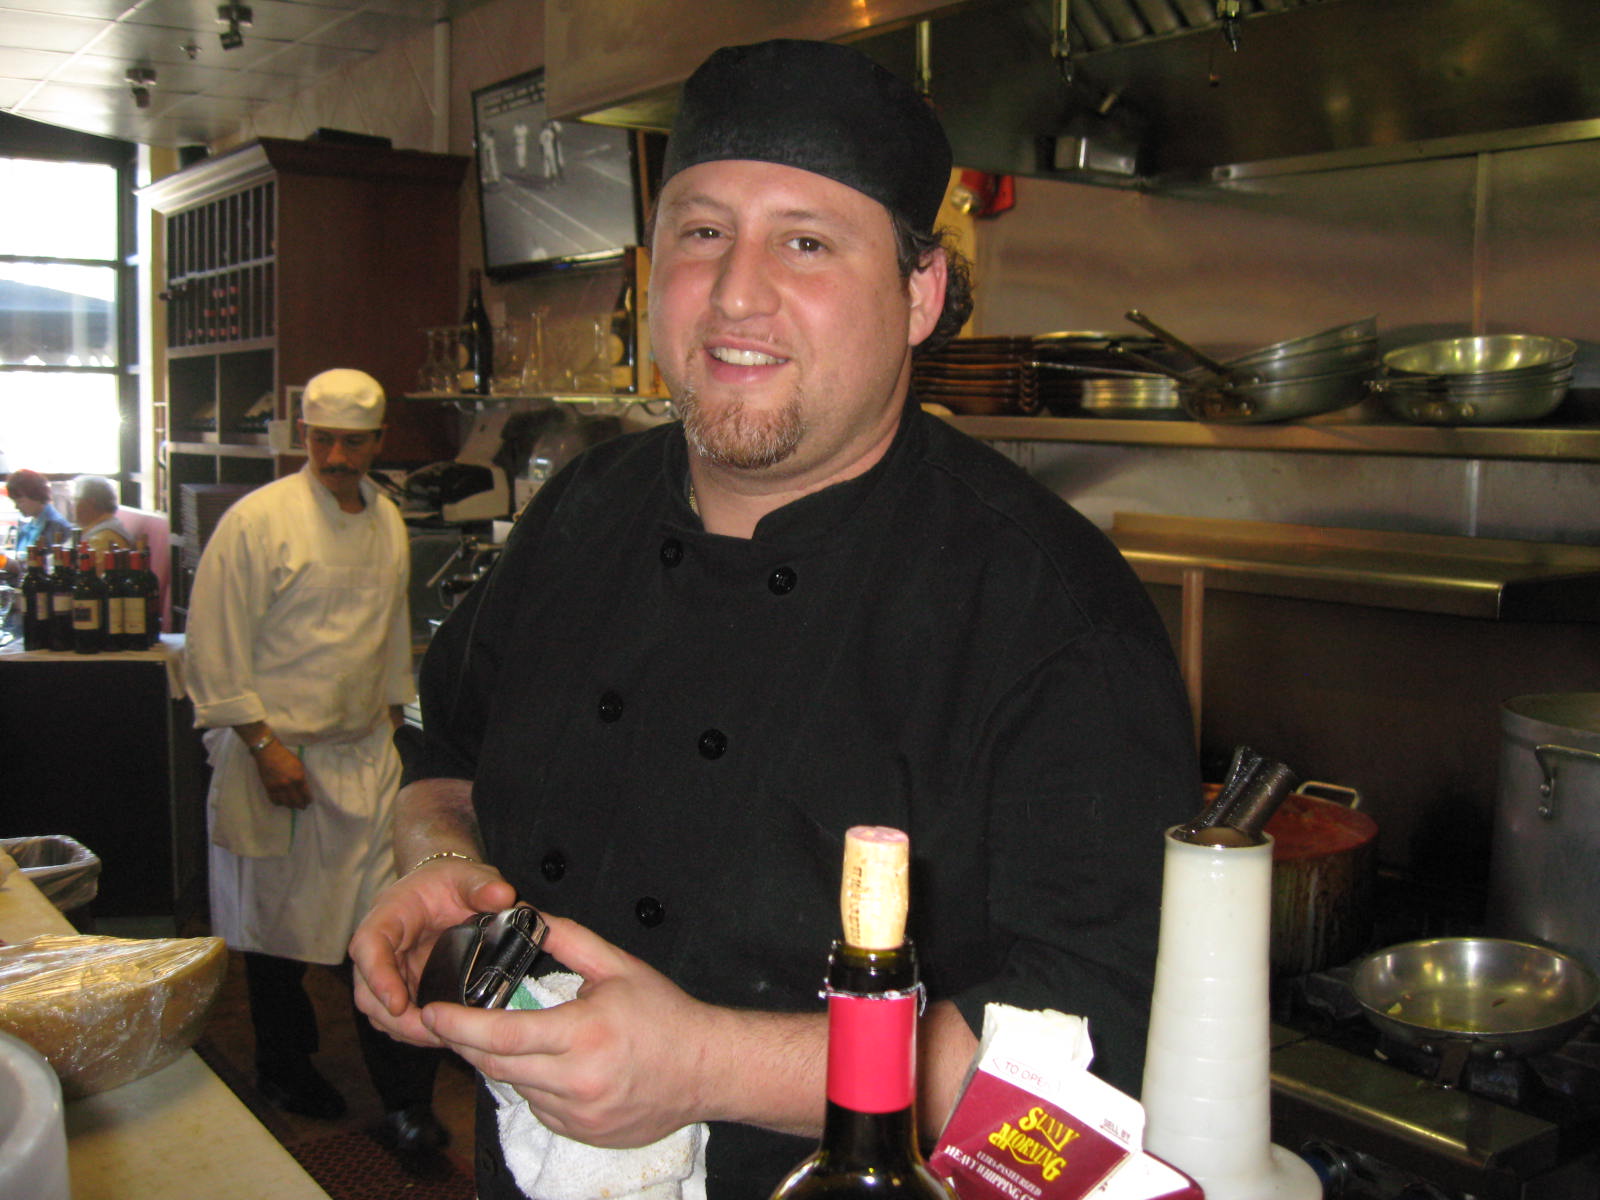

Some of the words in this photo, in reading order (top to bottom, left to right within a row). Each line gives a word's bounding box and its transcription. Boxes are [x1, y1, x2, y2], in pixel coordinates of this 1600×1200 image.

[1005, 1061, 1019, 1075] TO
[988, 1122, 1067, 1181] MORNING
[1018, 1106, 1080, 1152] SUNNY
[943, 1145, 978, 1170] HEAVY
[976, 1165, 1022, 1200] WHIPPING
